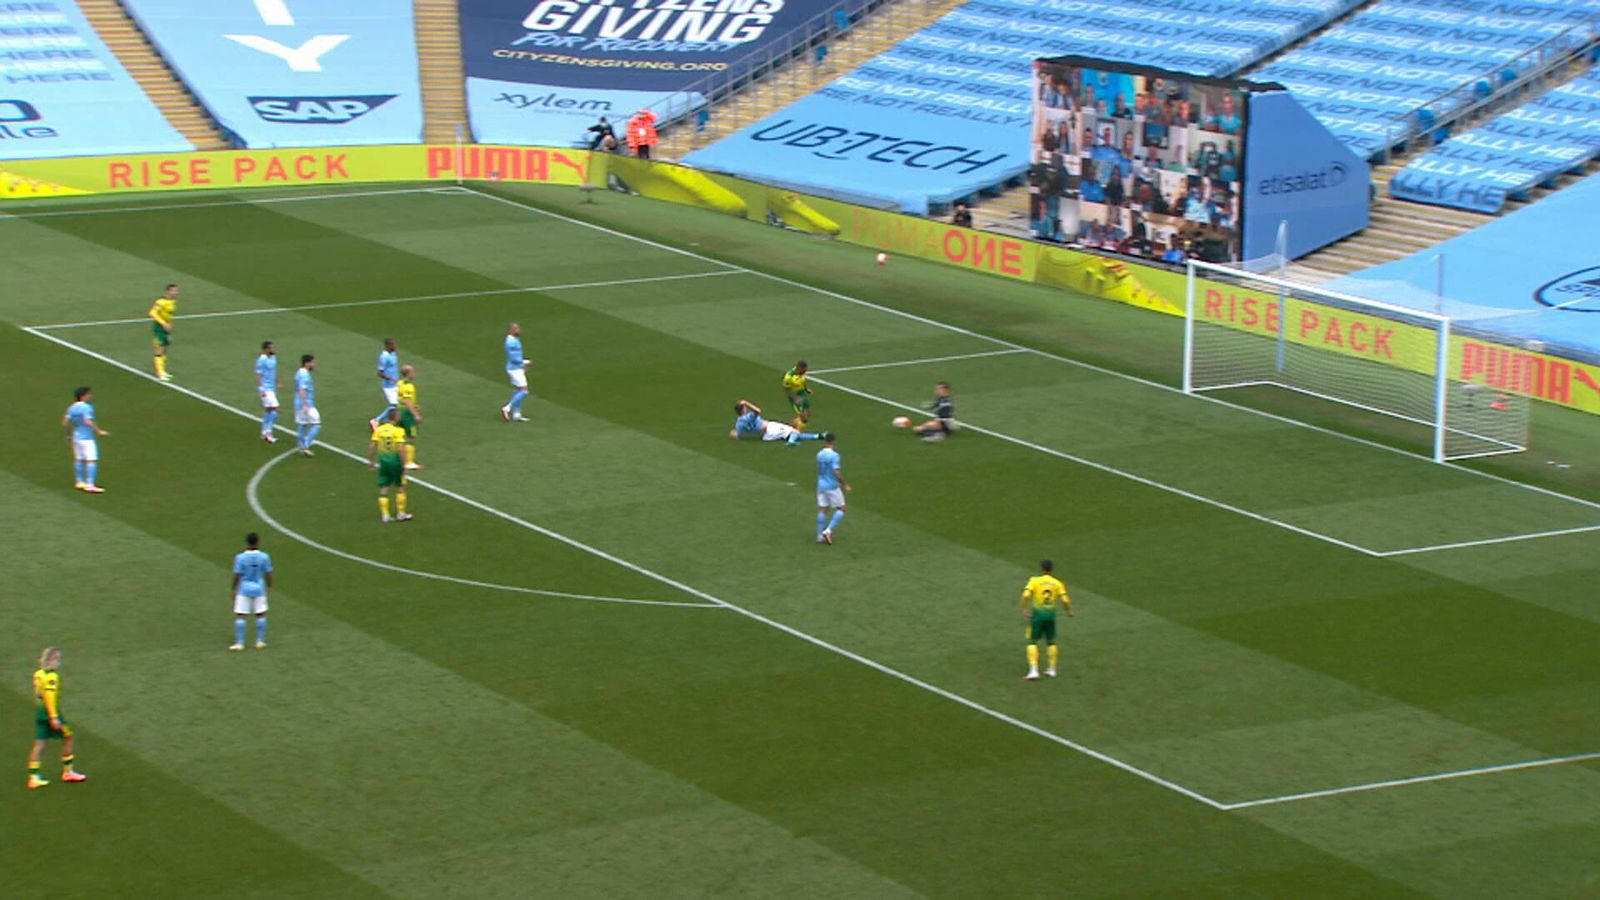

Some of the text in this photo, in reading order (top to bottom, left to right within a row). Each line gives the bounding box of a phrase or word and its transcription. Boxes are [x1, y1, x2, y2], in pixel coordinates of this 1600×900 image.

[521, 1, 774, 42] GIVING
[511, 32, 587, 48] FOR
[492, 49, 729, 71] CITYZENSGIVING.ORG
[5, 72, 114, 84] HERE
[493, 93, 613, 110] xylem
[852, 94, 917, 110] NOT
[874, 84, 939, 99] NOT
[254, 101, 370, 122] SAP
[750, 119, 1008, 174] UBTECH
[108, 153, 350, 189] RISE PACK
[427, 147, 549, 181] PUMA
[1205, 288, 1396, 359] RISE PACK
[1461, 342, 1571, 404] PUMA
